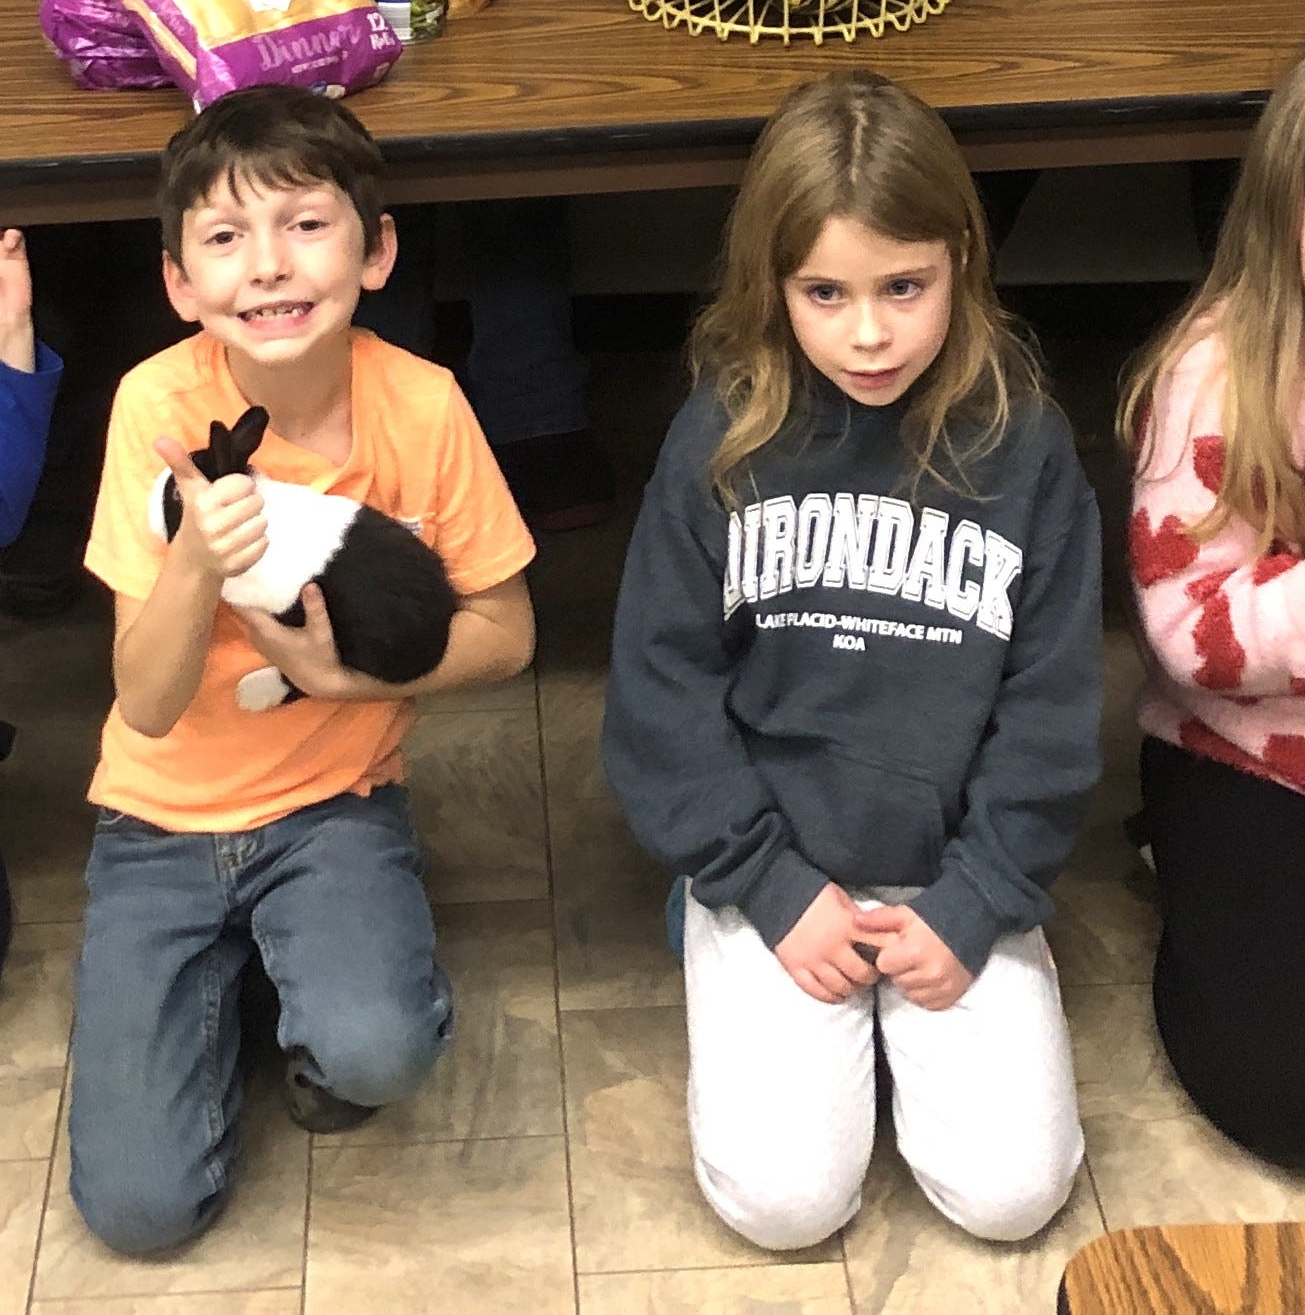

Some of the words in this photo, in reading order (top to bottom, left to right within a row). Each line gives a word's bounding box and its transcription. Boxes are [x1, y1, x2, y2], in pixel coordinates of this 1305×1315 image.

[253, 24, 362, 72] Dinner
[832, 634, 867, 652] KOA
[927, 626, 963, 645] MTN
